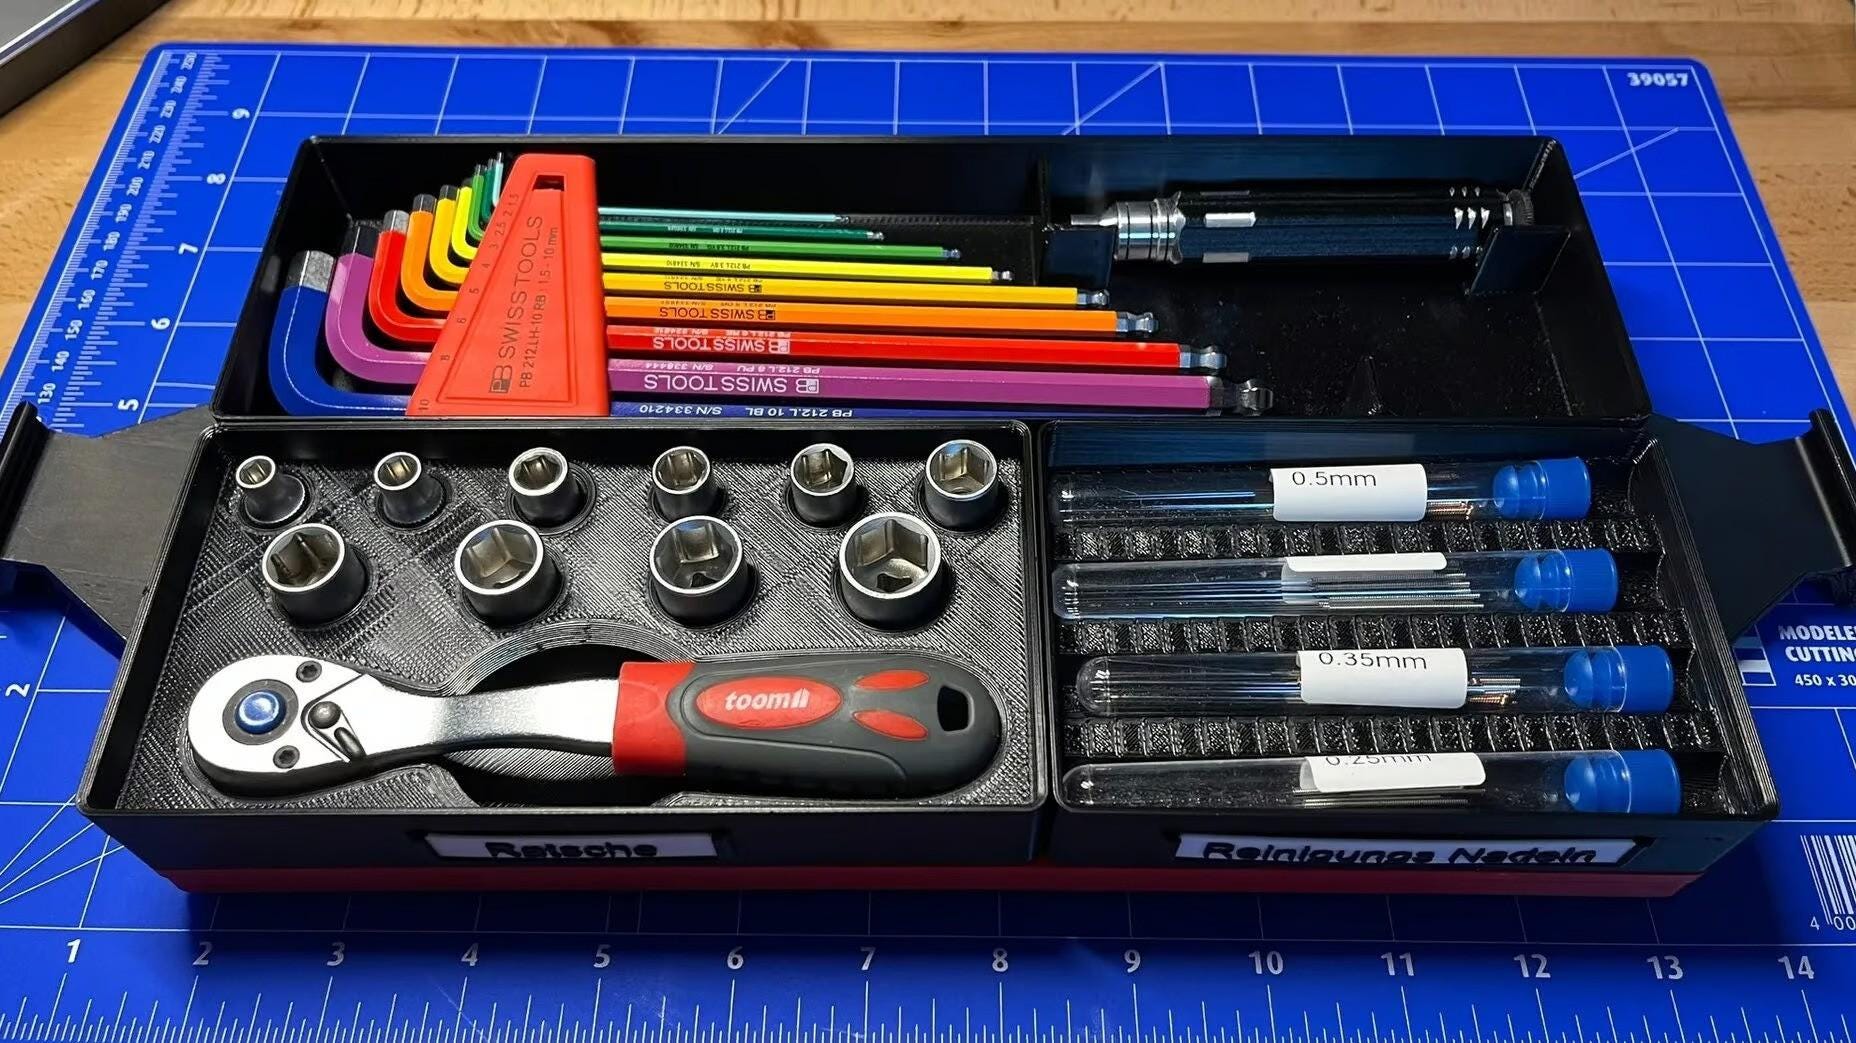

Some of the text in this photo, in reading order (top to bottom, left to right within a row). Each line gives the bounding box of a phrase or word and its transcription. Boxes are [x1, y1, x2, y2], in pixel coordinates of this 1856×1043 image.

[1627, 72, 1688, 86] 39057
[547, 227, 558, 245] mm
[118, 108, 250, 411] 5 6 7 8 9
[543, 247, 554, 260] 10
[38, 383, 56, 404] 130
[51, 351, 69, 372] 140
[65, 320, 82, 340] 150
[78, 289, 95, 310] 160
[91, 260, 108, 280] 170
[103, 231, 120, 251] 180
[126, 176, 143, 196] 200
[138, 150, 155, 169] 210
[149, 125, 165, 143] 220
[663, 281, 705, 291] TOOLS
[706, 282, 744, 292] SWISS
[488, 216, 543, 393] PB SWISS TOOLS
[533, 294, 546, 310] RB
[659, 306, 708, 319] TOOLS
[710, 308, 754, 320] SWISS
[418, 399, 429, 412] 10
[469, 287, 479, 295] 5
[653, 336, 711, 351] TOOLS
[713, 338, 765, 352] SWISS
[692, 363, 714, 371] S/N
[769, 366, 799, 374] 212.L
[519, 372, 533, 388] PB
[644, 374, 719, 391] TOOLS
[721, 376, 788, 393] SWISS
[639, 404, 853, 417] PB 212.L 10 BL S/N 334210
[1292, 471, 1377, 487] 0.5mm
[1778, 625, 1856, 641] MODELE
[1319, 652, 1427, 670] 0.35mm
[1785, 646, 1856, 662] CUTTIN
[1795, 674, 1822, 686] 450
[1825, 676, 1836, 686] x
[5, 683, 30, 698] 2
[724, 691, 791, 711] toom
[1810, 916, 1820, 930] 4
[66, 938, 1815, 980] 1 2 3 4 5 6 7 8 9 10 11 12 13 14
